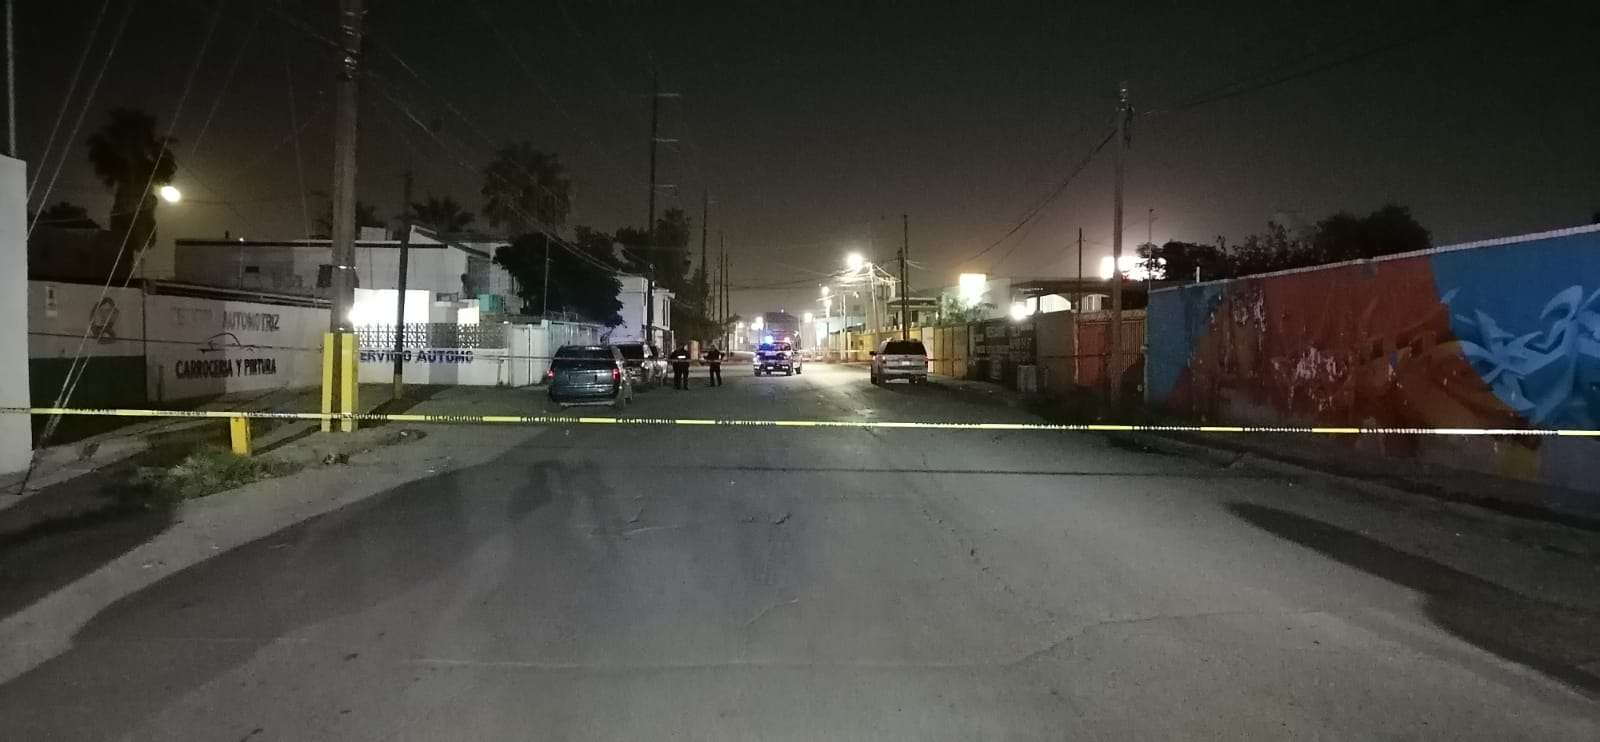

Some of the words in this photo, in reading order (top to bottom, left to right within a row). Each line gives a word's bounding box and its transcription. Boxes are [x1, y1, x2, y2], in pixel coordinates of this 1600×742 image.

[416, 350, 474, 362] AUTOMO
[235, 359, 242, 377] Y
[244, 358, 276, 376] PINTURA
